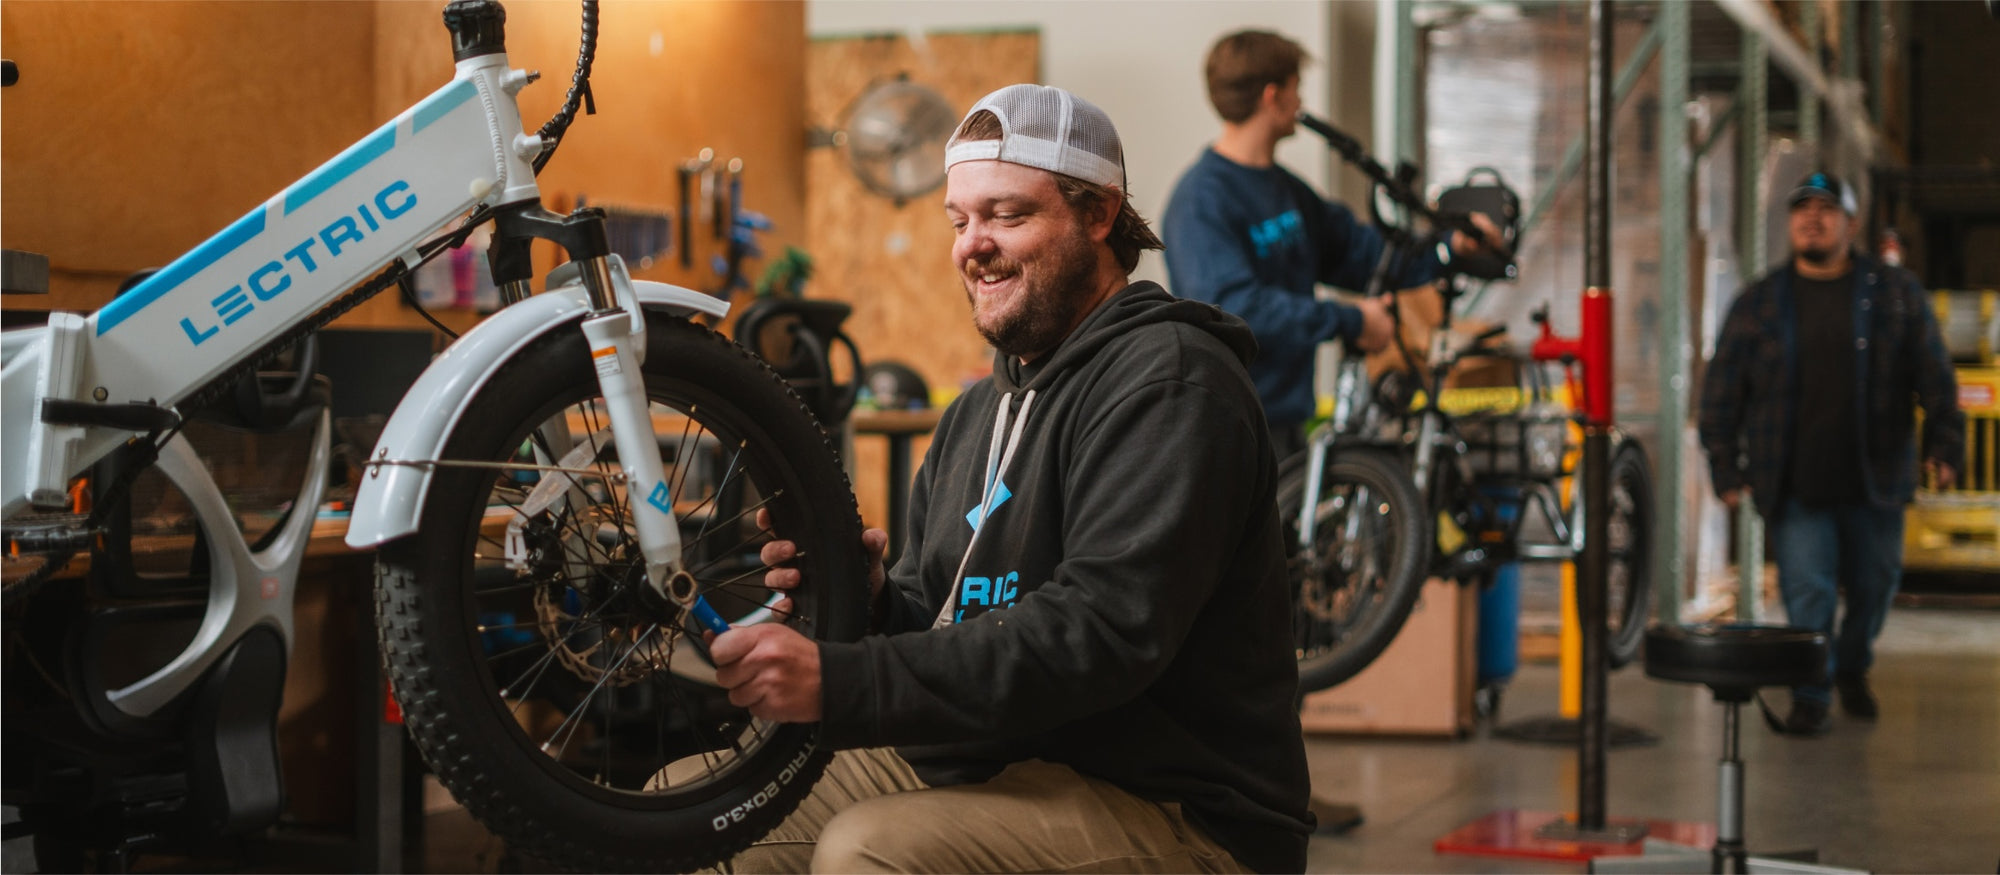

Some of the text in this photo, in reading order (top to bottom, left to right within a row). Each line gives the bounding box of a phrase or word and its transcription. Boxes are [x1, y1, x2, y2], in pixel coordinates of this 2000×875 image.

[180, 180, 417, 346] LECTRIC
[712, 735, 817, 831] TRIC 20x3.0
